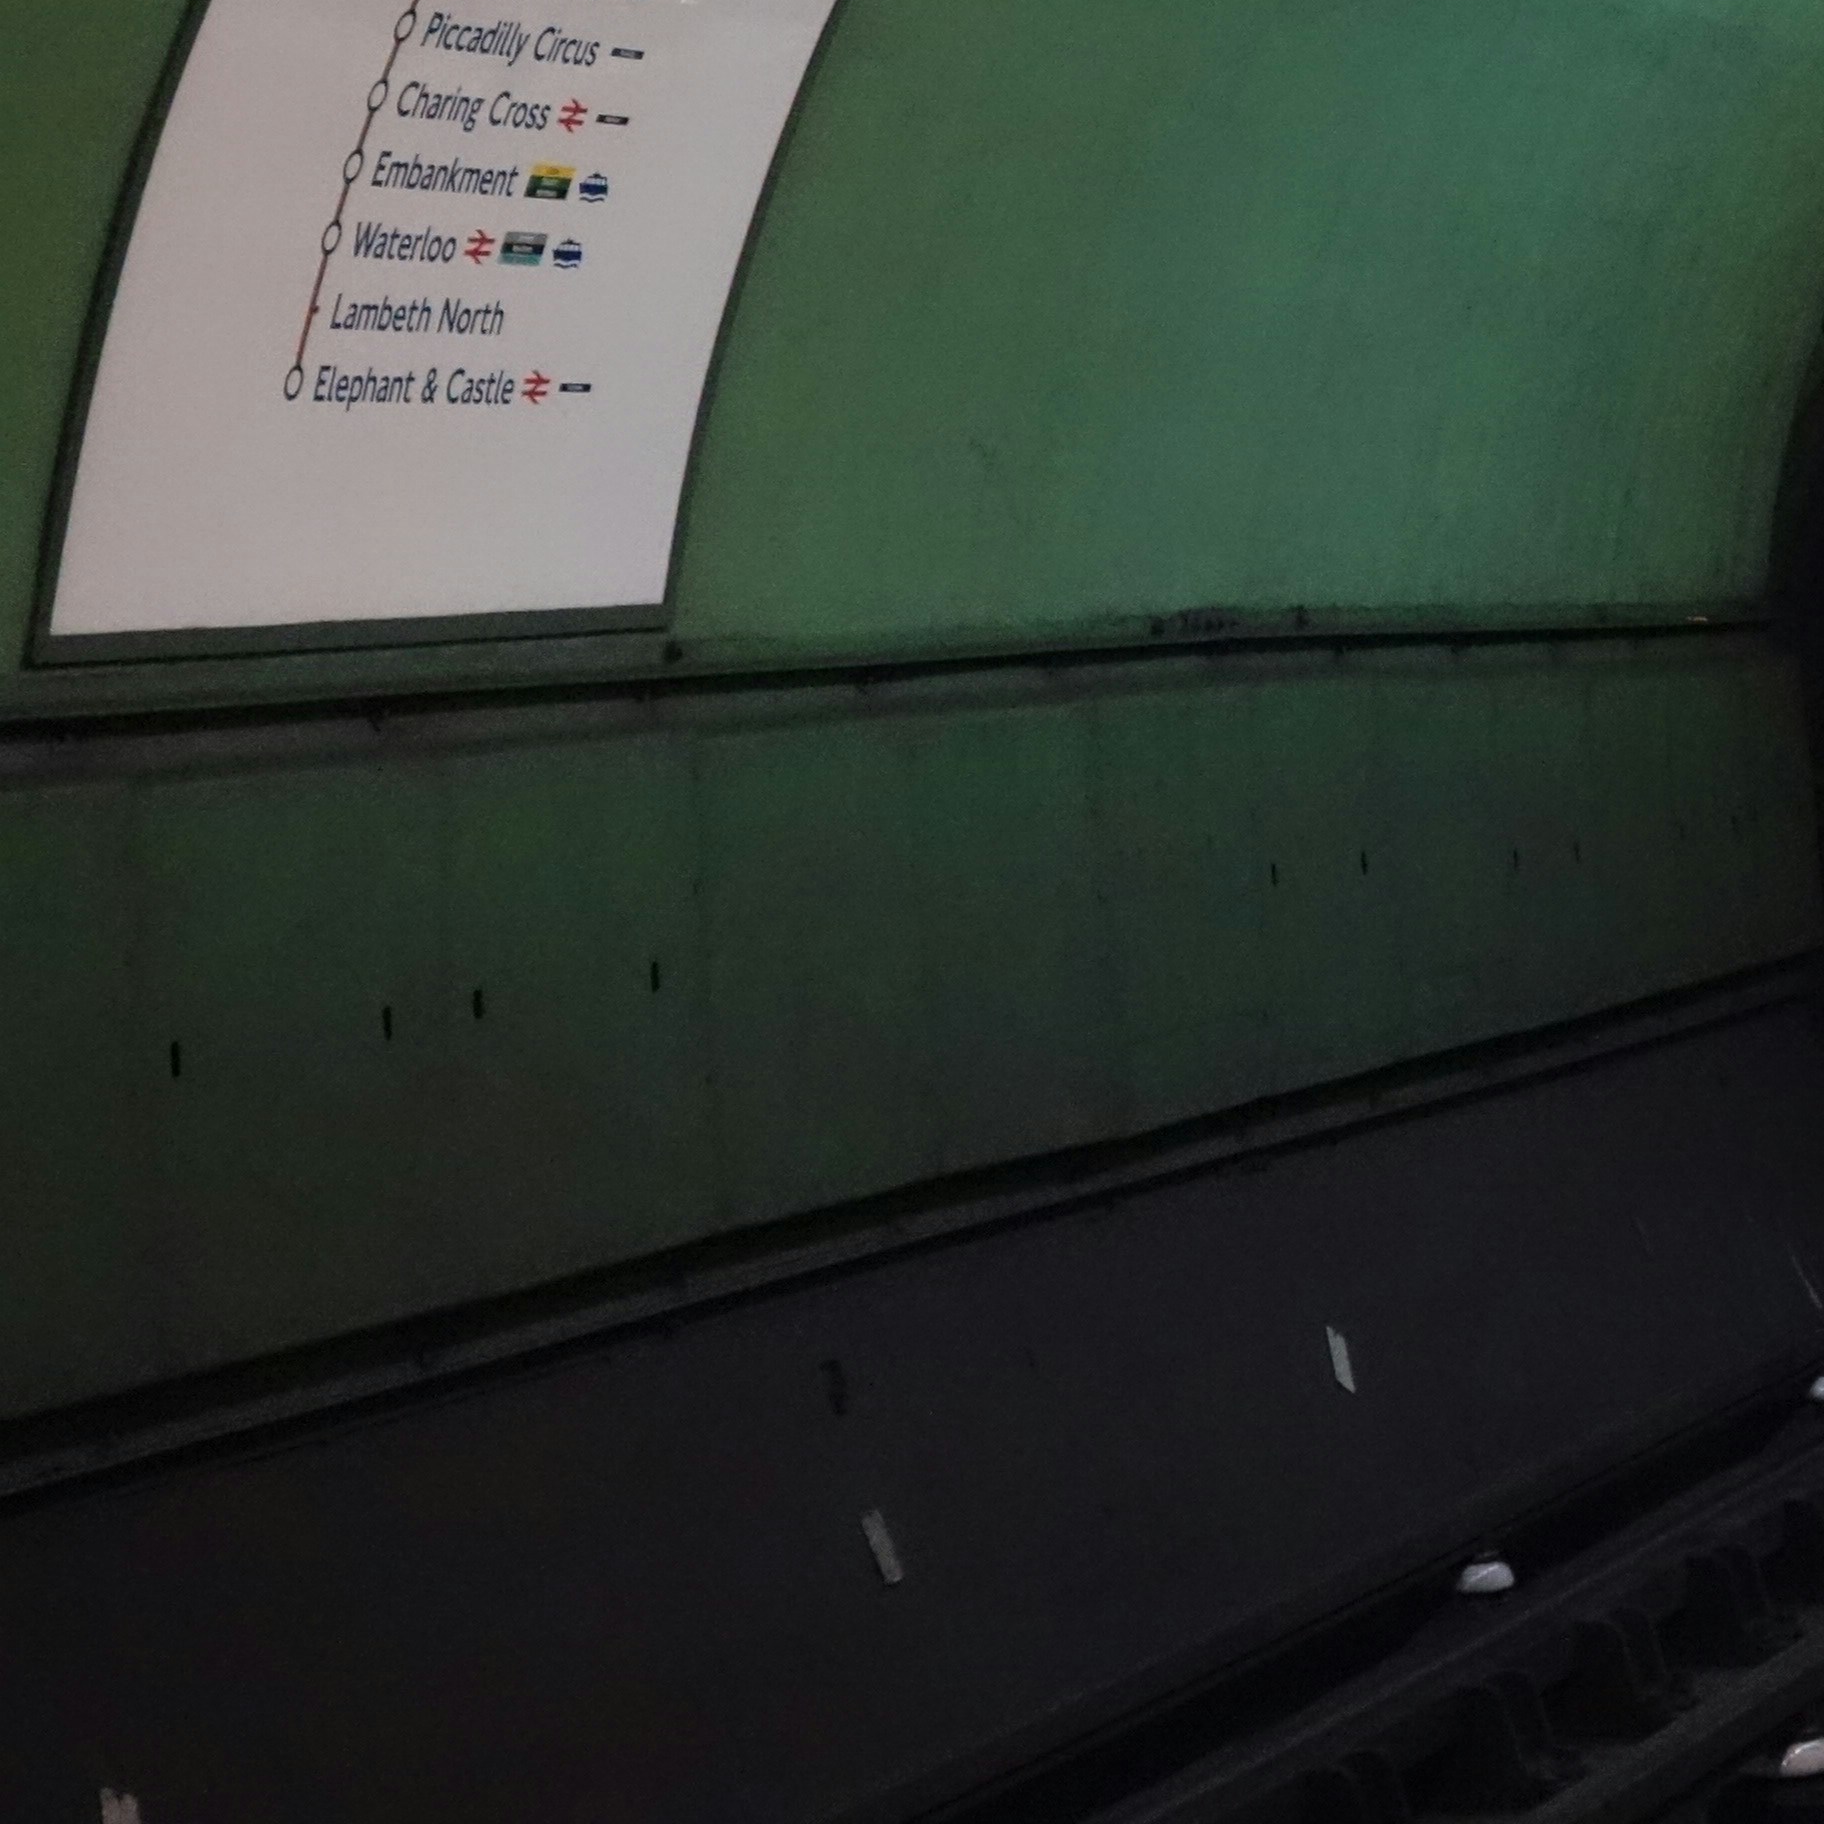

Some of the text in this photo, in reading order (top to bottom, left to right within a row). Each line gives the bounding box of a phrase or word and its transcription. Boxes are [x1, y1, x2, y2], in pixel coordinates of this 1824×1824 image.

[420, 11, 601, 67] Piccadilly Circus
[396, 80, 552, 132] Charing Cross
[371, 150, 520, 198] Embankment
[352, 221, 457, 263] Waterloo
[329, 292, 505, 336] Lambeth North
[312, 365, 516, 412] Elephant & Castle
